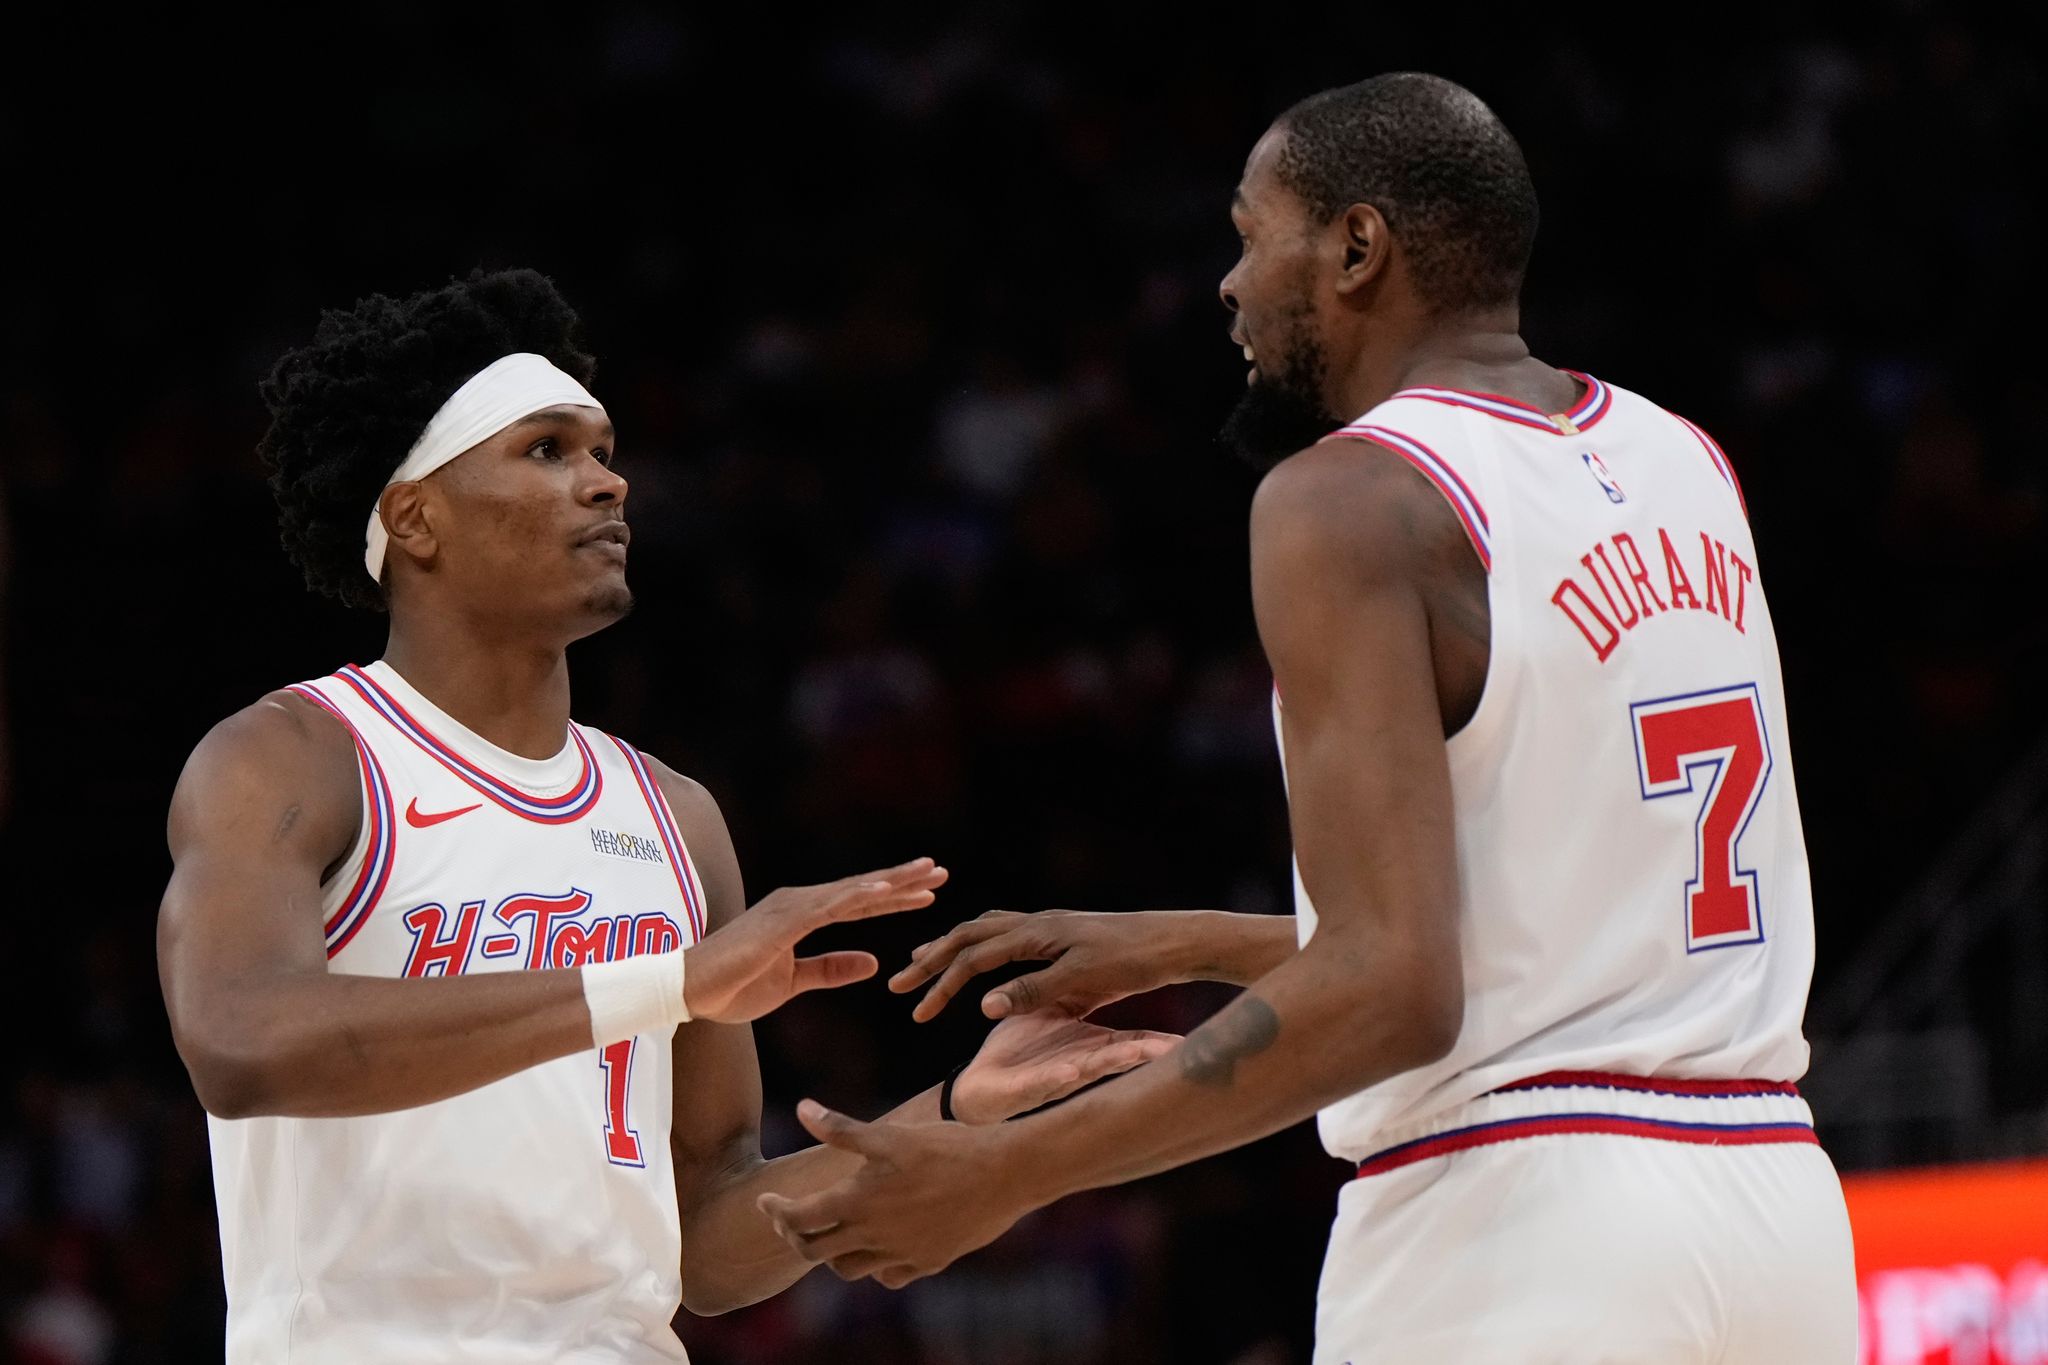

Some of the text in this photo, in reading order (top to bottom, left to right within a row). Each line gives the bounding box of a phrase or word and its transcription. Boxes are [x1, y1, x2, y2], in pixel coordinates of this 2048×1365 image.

[1551, 528, 1752, 663] DURANT
[591, 827, 660, 852] MEMORIAL
[593, 839, 663, 864] HERMANN
[1630, 682, 1772, 955] 7
[403, 887, 682, 978] H-Town
[599, 1035, 645, 1168] 1
